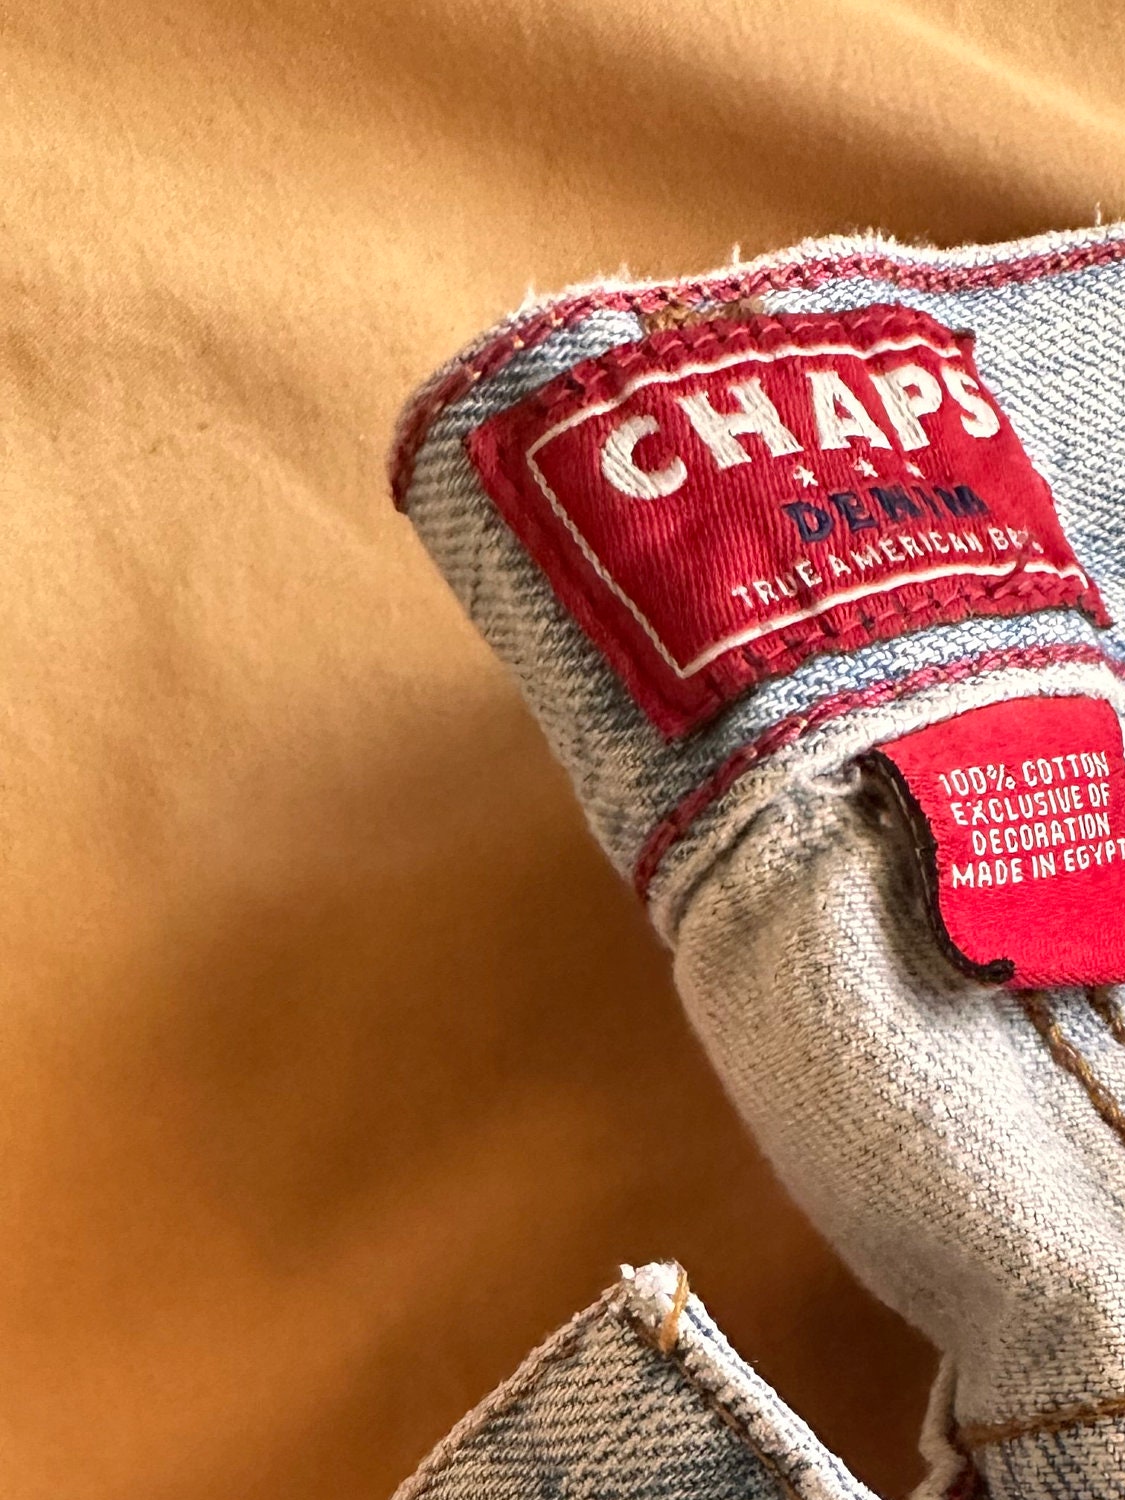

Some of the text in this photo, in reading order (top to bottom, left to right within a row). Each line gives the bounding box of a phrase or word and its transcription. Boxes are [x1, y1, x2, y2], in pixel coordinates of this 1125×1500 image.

[600, 363, 1000, 499] CHAPS
[781, 484, 991, 543] DENIM
[732, 558, 822, 608] TRUE
[828, 529, 984, 578] AMERICAN
[939, 751, 1110, 796] 100% COTTON
[951, 783, 1111, 826] EXCLUSIVE OF
[972, 813, 1111, 856] DECORATION
[952, 857, 1024, 889] MADE
[1031, 852, 1056, 879] IN
